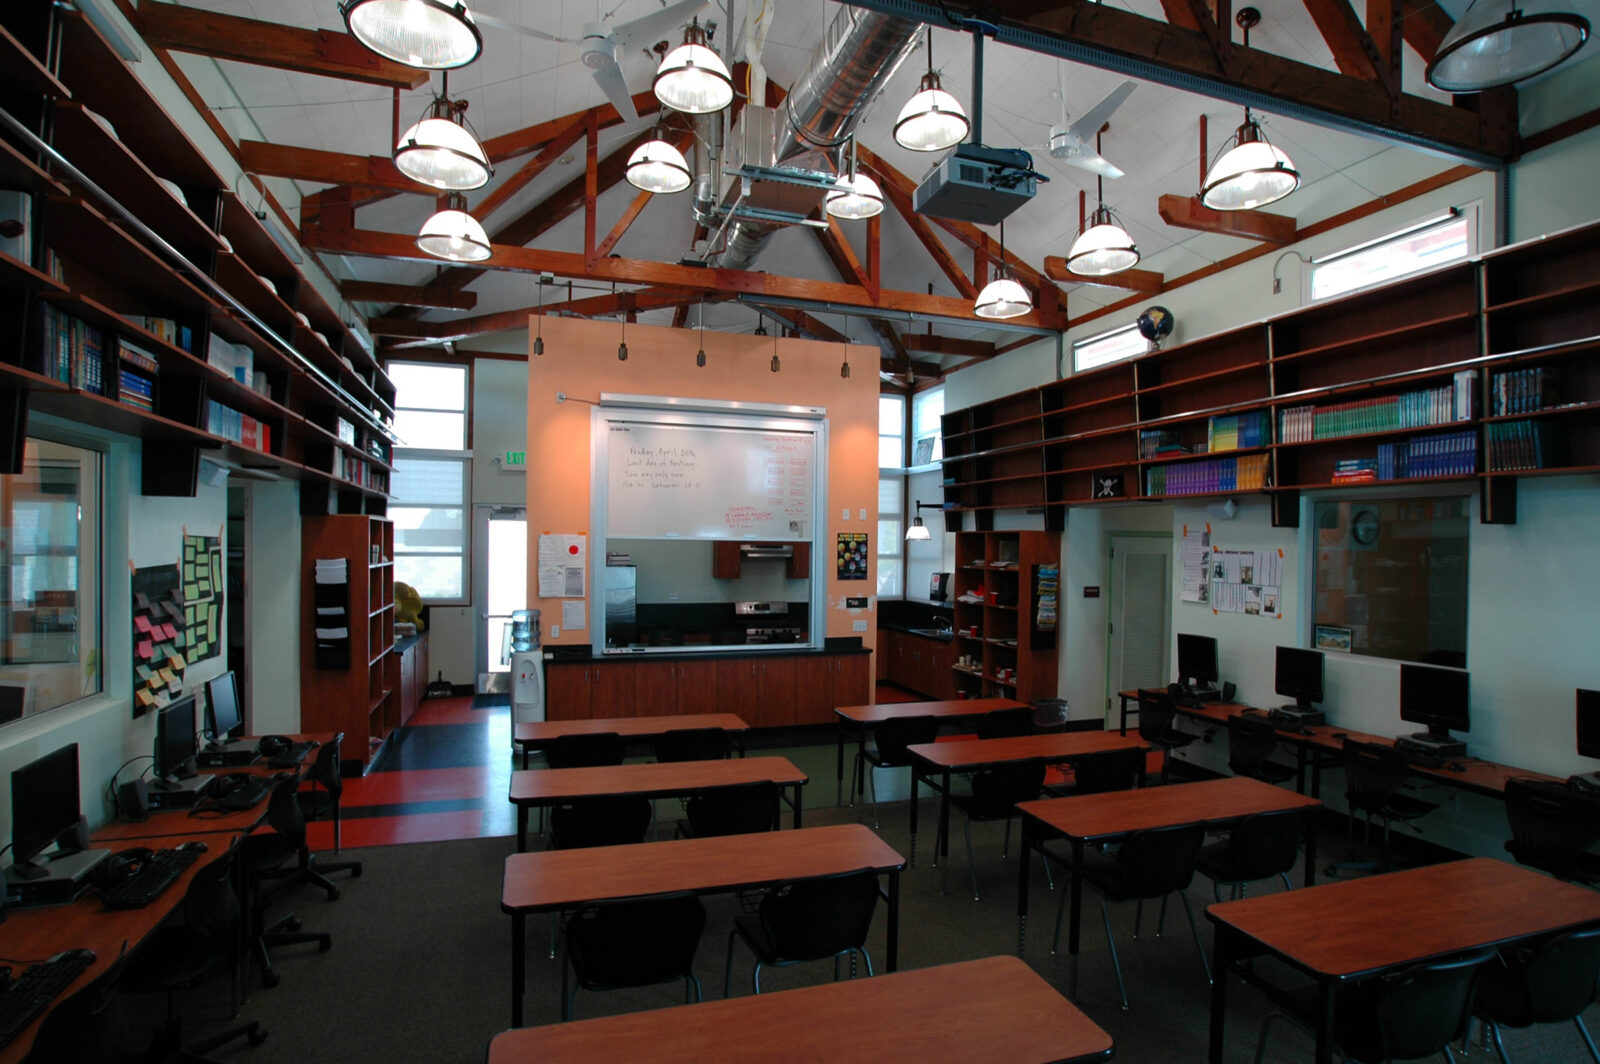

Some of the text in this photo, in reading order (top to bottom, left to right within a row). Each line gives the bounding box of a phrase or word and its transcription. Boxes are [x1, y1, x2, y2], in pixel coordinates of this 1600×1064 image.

[658, 447, 676, 457] April
[506, 451, 525, 464] EXIT
[646, 459, 657, 469] day
